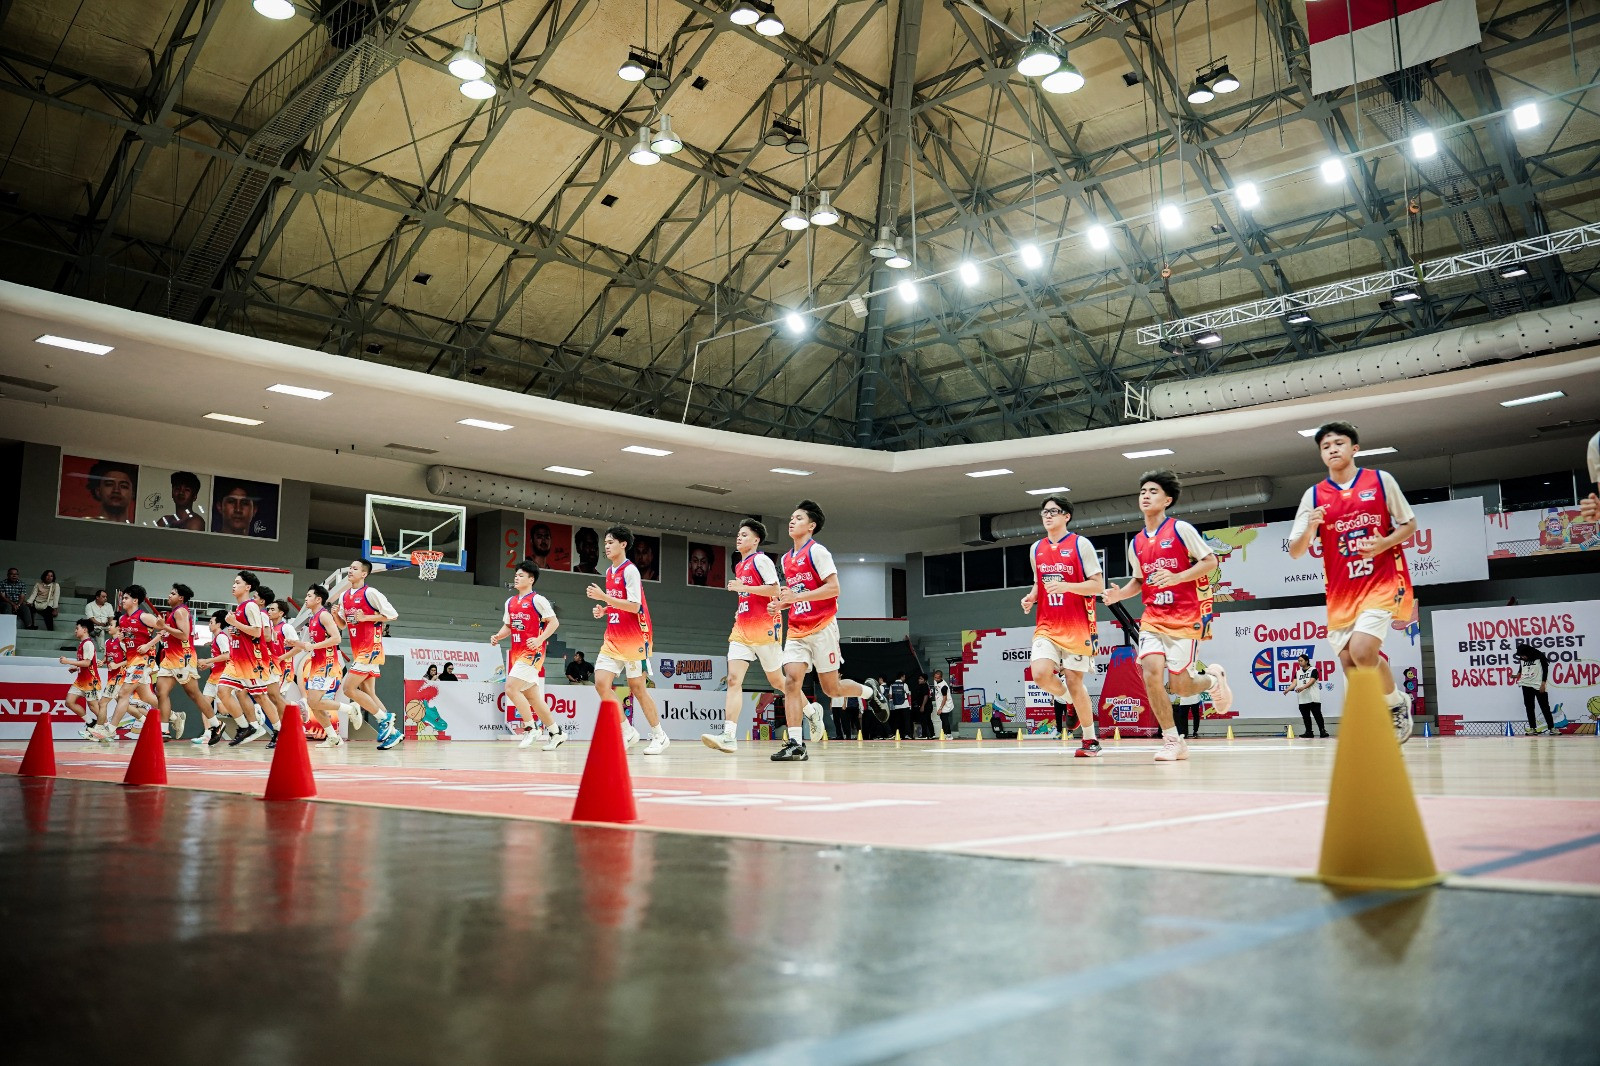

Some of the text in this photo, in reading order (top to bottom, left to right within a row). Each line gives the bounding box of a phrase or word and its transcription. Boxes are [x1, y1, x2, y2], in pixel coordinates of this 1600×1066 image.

[504, 529, 519, 568] C 2
[1347, 558, 1374, 578] 125
[1414, 562, 1434, 571] RASA
[1284, 573, 1318, 583] KARENA
[1047, 593, 1064, 606] 117
[1467, 614, 1575, 640] INDONESIA'S
[1290, 648, 1308, 658] DBL
[1458, 640, 1495, 653] BEST
[1499, 638, 1512, 651] &
[1470, 654, 1509, 666] HIGH
[1552, 662, 1600, 686] CAMP
[661, 700, 726, 720] Jackson
